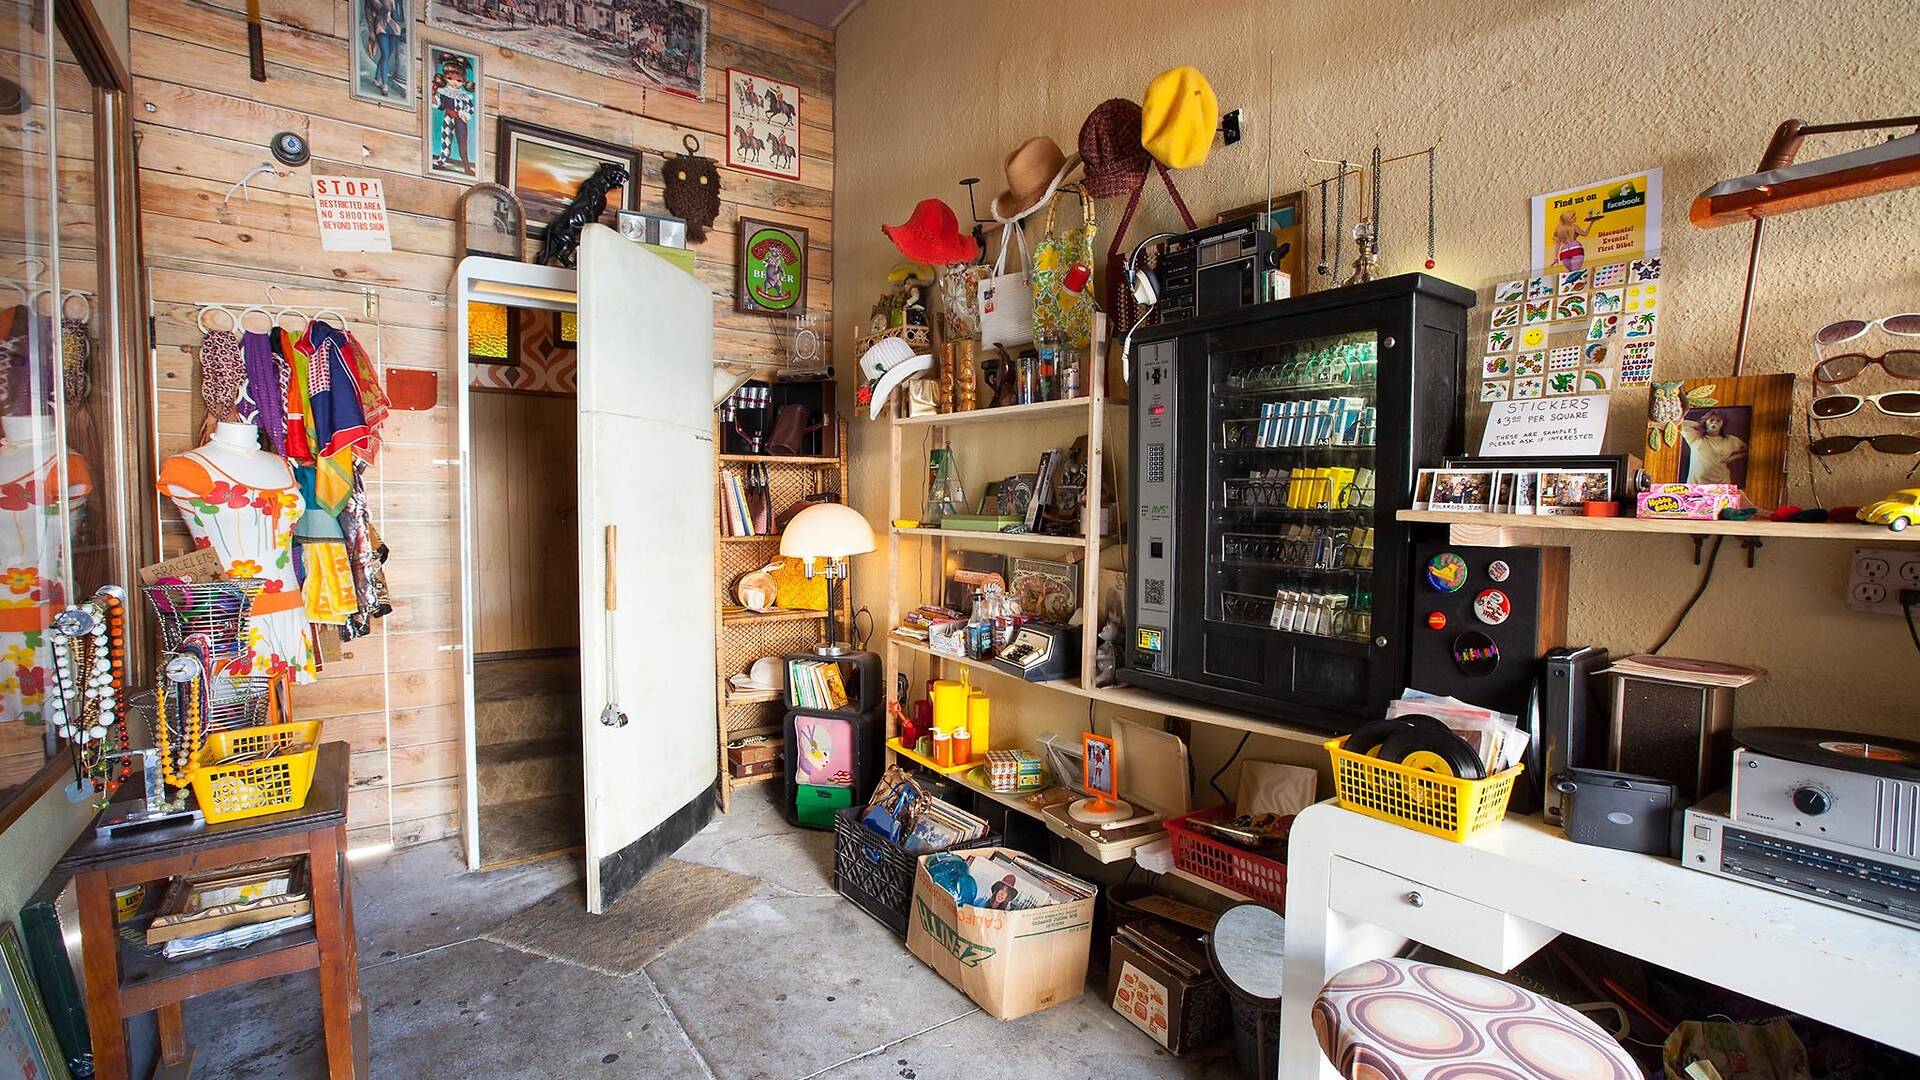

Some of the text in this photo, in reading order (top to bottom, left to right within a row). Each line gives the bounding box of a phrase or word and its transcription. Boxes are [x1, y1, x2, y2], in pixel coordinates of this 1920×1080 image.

[316, 179, 380, 198] STOP!
[319, 200, 382, 211] RESTRICTED AREA
[1554, 193, 1641, 210] Find us on facebook
[321, 211, 384, 221] NO SHOOTING
[323, 221, 385, 231] BEYOND THIS SIGN
[1598, 226, 1634, 238] Discounts!
[1602, 234, 1629, 245] Events!
[1597, 240, 1634, 253] First Dibs!
[1507, 398, 1591, 414] STICKERS
[1528, 415, 1545, 424] PER
[1550, 411, 1589, 422] SQUARE
[1488, 440, 1516, 448] PLEASE
[1548, 433, 1594, 442] INTERESTED
[1496, 433, 1518, 441] THESE
[1543, 427, 1578, 436] SAMPLES
[1318, 438, 1329, 446] A-3
[152, 552, 214, 578] BRACELETS
